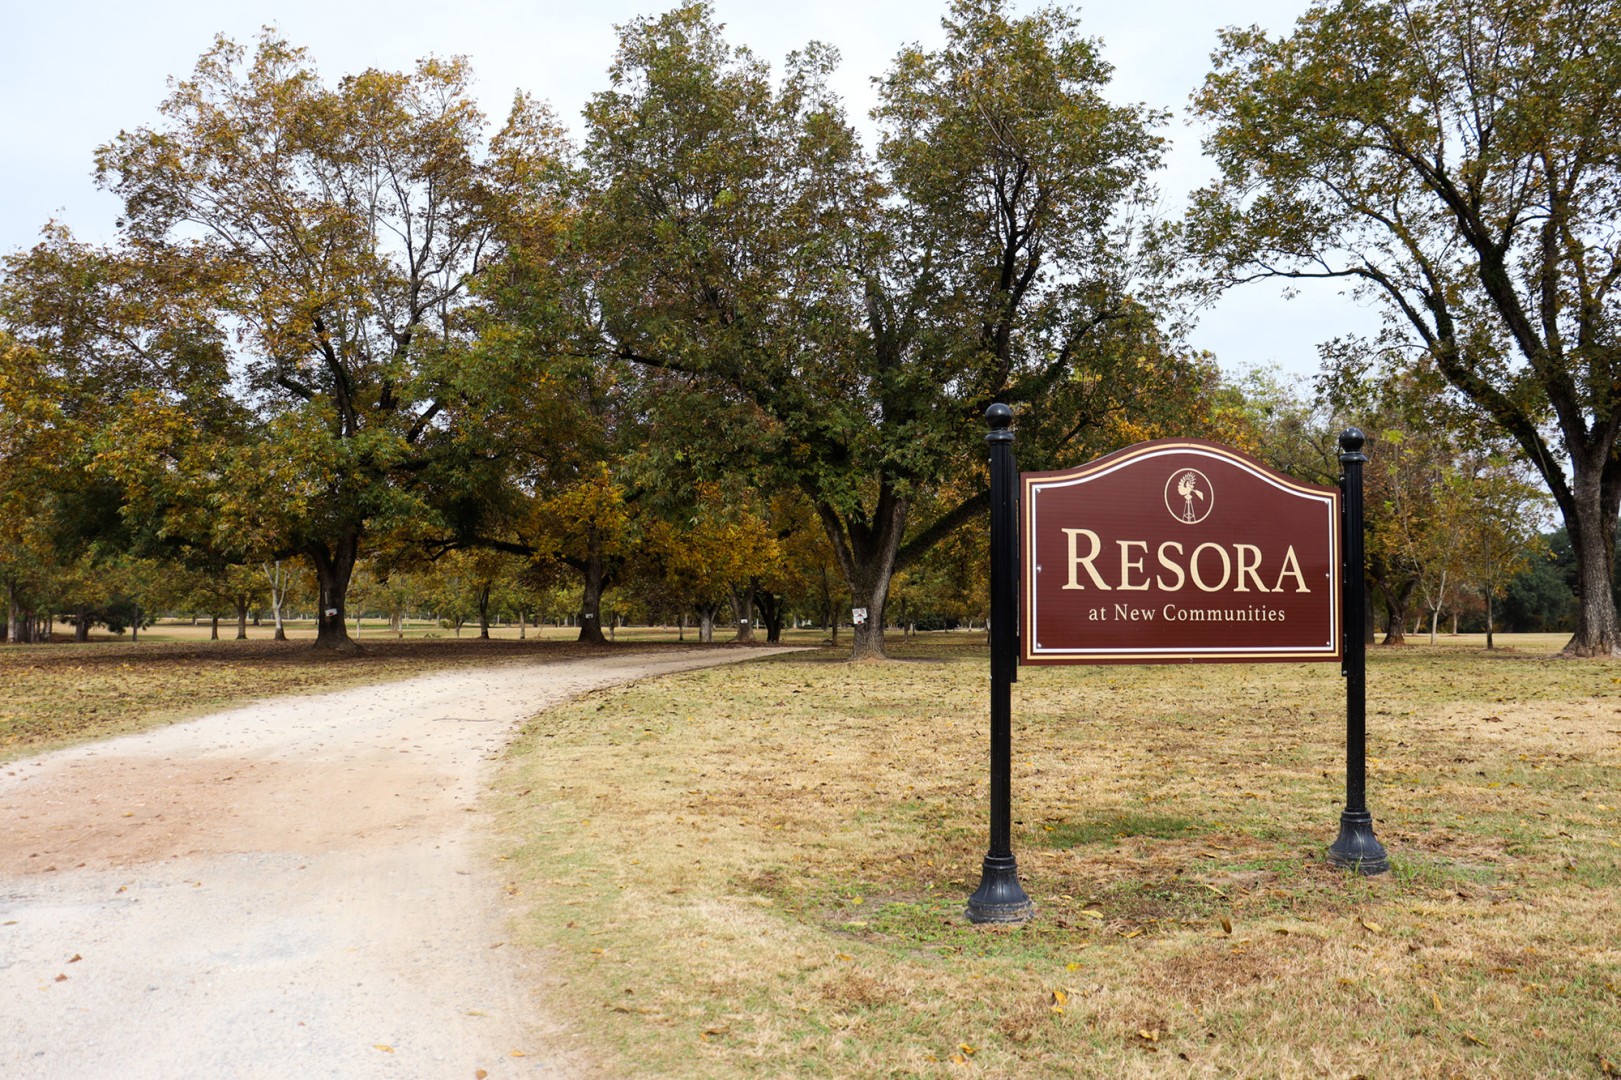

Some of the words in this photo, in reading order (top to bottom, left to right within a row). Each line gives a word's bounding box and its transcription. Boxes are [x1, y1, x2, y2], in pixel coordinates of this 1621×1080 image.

[1061, 527, 1311, 592] RESORA
[1089, 607, 1107, 621] at
[1114, 604, 1156, 621] New
[1163, 604, 1286, 622] Communities
